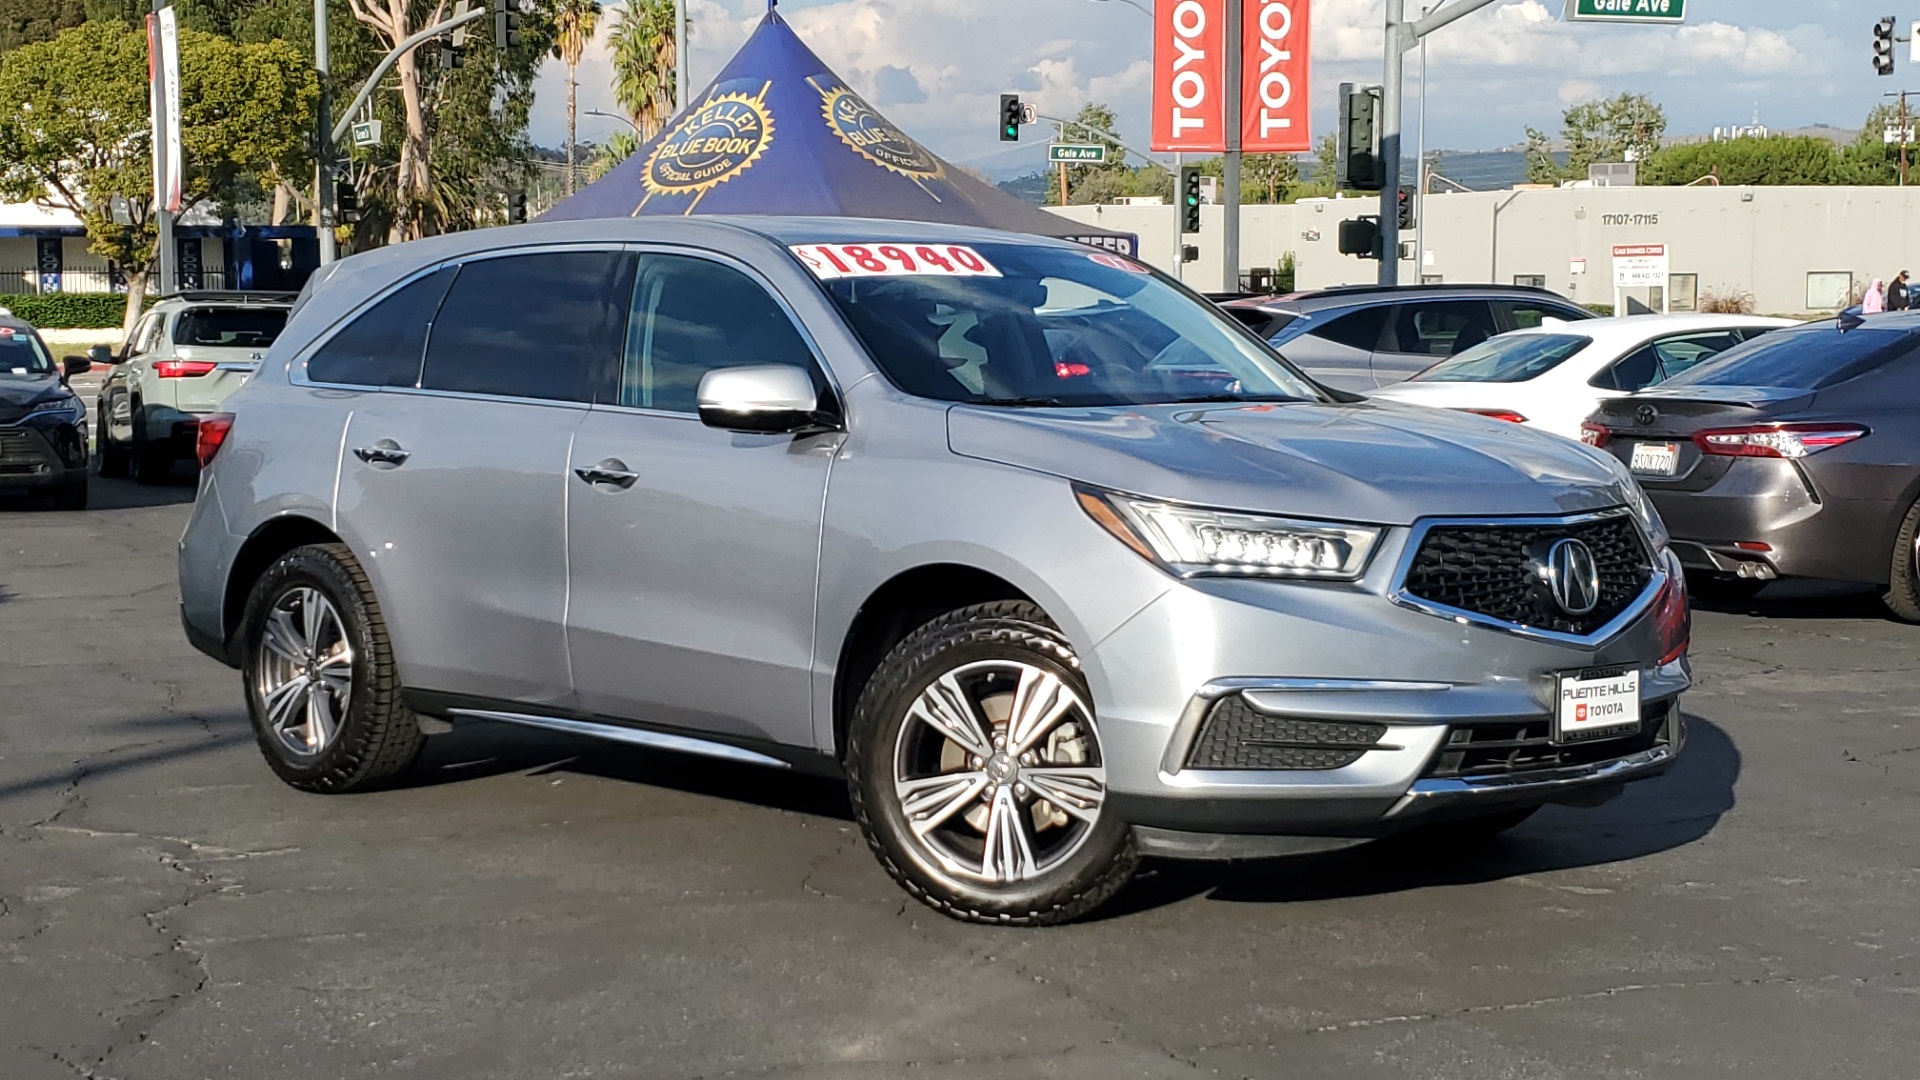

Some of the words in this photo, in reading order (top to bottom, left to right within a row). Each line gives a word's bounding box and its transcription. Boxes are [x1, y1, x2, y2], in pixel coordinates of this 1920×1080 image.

[1171, 0, 1205, 139] TOYO
[1259, 0, 1292, 139] TOYO
[684, 105, 757, 135] KELLEY
[658, 138, 705, 159] BLUE
[702, 137, 756, 154] BOOK
[1057, 149, 1077, 158] Gale
[1079, 149, 1097, 158] Ave
[693, 158, 733, 179] GUIDE
[1602, 213, 1659, 225] 17107-17115
[1562, 685, 1607, 700] PUENTE
[1608, 681, 1635, 695] HILLS
[1590, 702, 1623, 716] TOYOTA
